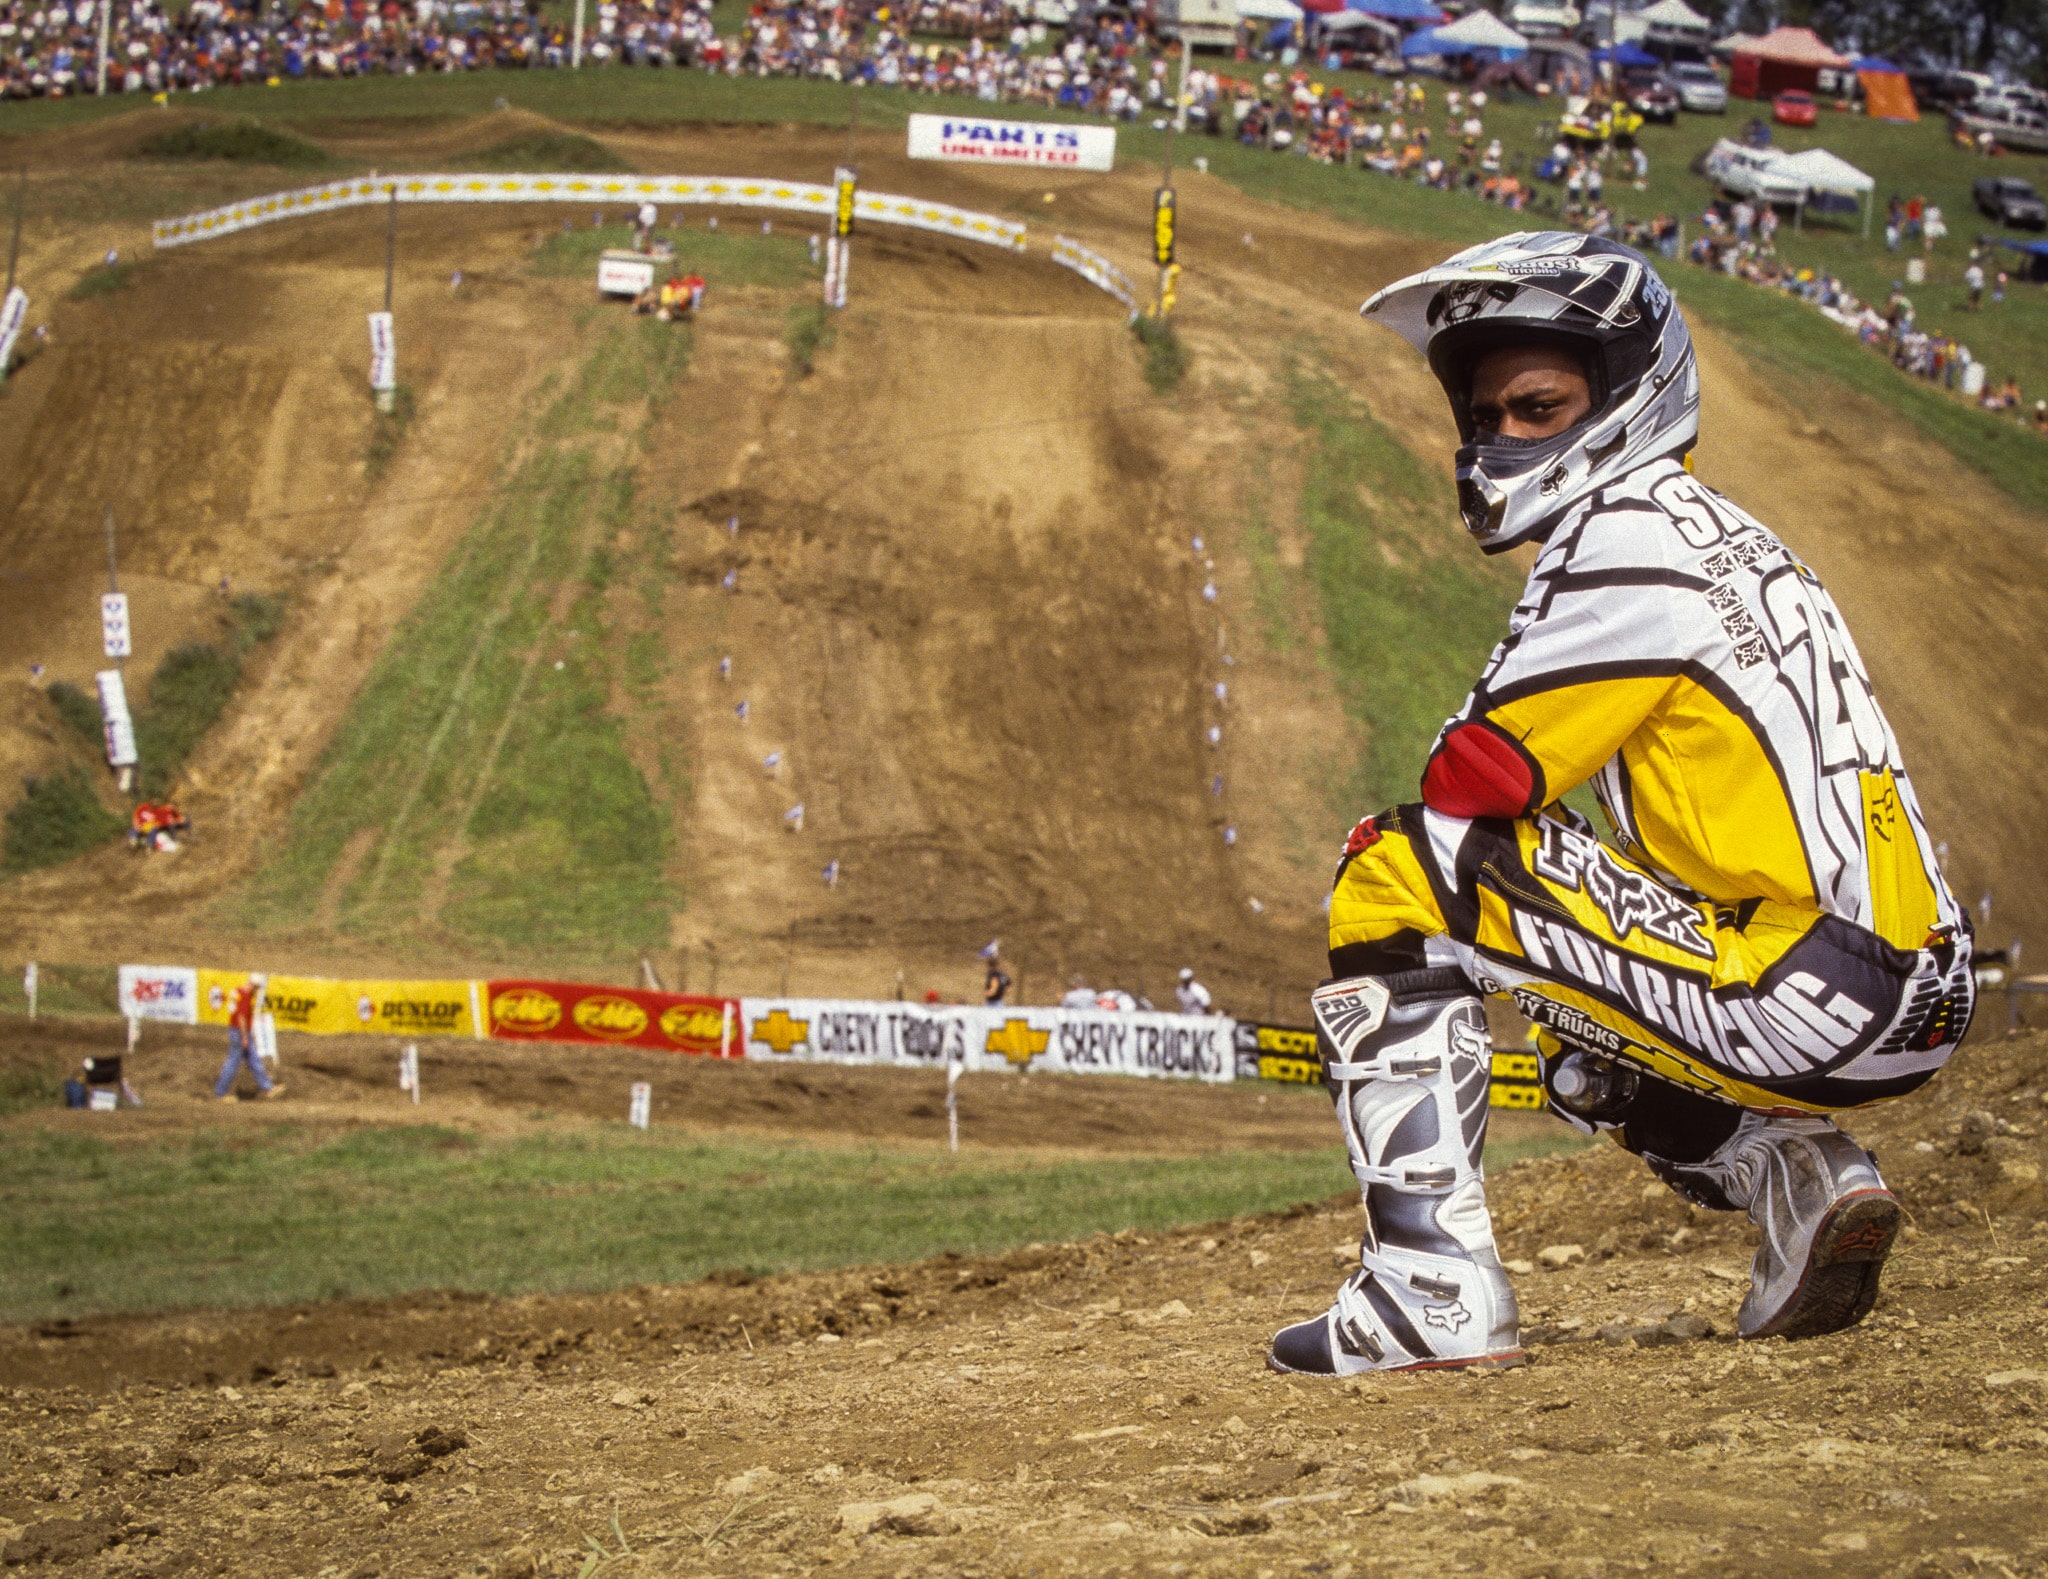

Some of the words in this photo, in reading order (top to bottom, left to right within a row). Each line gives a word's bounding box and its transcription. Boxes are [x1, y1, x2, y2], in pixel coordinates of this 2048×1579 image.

[943, 122, 1078, 147] PARTS
[941, 144, 1078, 163] UNLIMITED
[1498, 257, 1580, 271] boost
[1508, 267, 1560, 276] mobile
[263, 996, 318, 1014] NLOP
[1318, 995, 1362, 1013] PRO
[1514, 908, 1638, 1010] FOX
[1629, 960, 1876, 1078] RACING
[1516, 990, 1586, 1018] TEAM
[381, 1001, 464, 1019] DUNLOP
[819, 1012, 879, 1054] CHEVY
[1257, 1026, 1317, 1055] SCOT
[1546, 1006, 1621, 1050] TRUCKS
[1060, 1022, 1127, 1065] CHEVY
[1136, 1025, 1222, 1074] TRUCKS
[1258, 1055, 1323, 1085] SCOT
